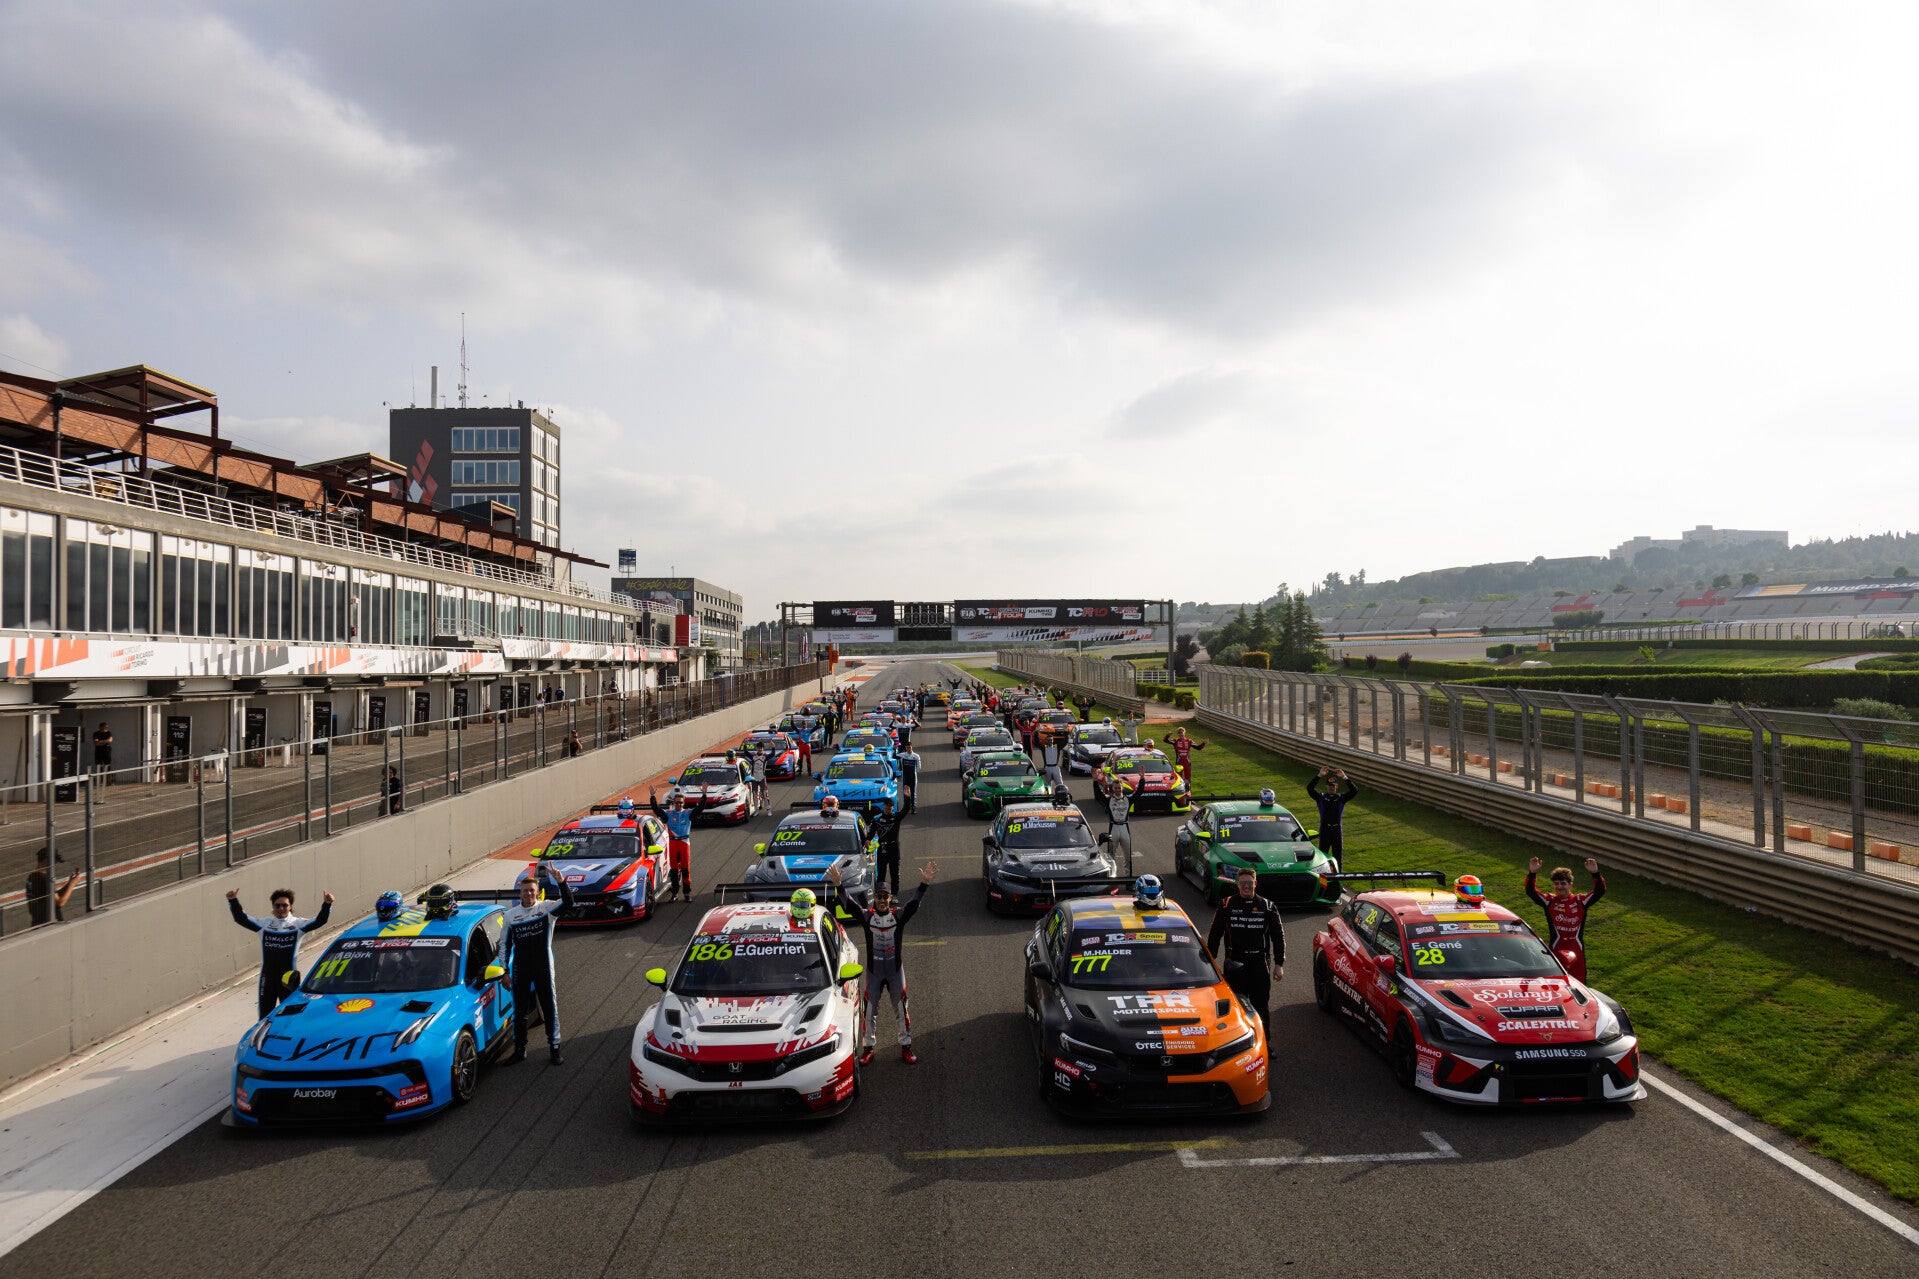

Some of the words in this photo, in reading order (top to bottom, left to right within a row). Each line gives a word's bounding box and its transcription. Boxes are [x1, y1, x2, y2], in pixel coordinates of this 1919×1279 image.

[960, 608, 976, 619] FIA
[977, 608, 998, 616] TCR
[1007, 824, 1021, 833] 18
[1220, 829, 1231, 837] 11
[776, 831, 803, 841] 107
[545, 845, 573, 856] 129
[1365, 908, 1378, 925] 28
[1105, 933, 1137, 942] TCR
[342, 941, 358, 950] FIA
[735, 943, 806, 957] E.Guerrieri
[1428, 941, 1462, 949] Gené
[688, 943, 733, 962] 186
[1083, 949, 1132, 957] M.HALDER
[1415, 948, 1446, 965] 28
[315, 959, 351, 979] 111
[1071, 955, 1112, 974] 777
[1332, 975, 1363, 1005] SCALEXTRIC
[1473, 989, 1562, 1002] Solaray
[1107, 994, 1195, 1008] TPR
[1496, 1005, 1560, 1013] CUPRA
[1498, 1020, 1580, 1031] SCALEXTRIC
[1416, 1044, 1442, 1058] KUMHO
[1515, 1049, 1568, 1059] SAMSUNG
[1570, 1049, 1587, 1057] SSD
[1054, 1059, 1080, 1076] KUMHO
[1245, 1057, 1264, 1072] KUMHO
[835, 1075, 853, 1091] KUMHO
[1054, 1072, 1071, 1087] HC
[293, 1088, 337, 1099] Aurobay
[395, 1094, 429, 1108] KUMHO
